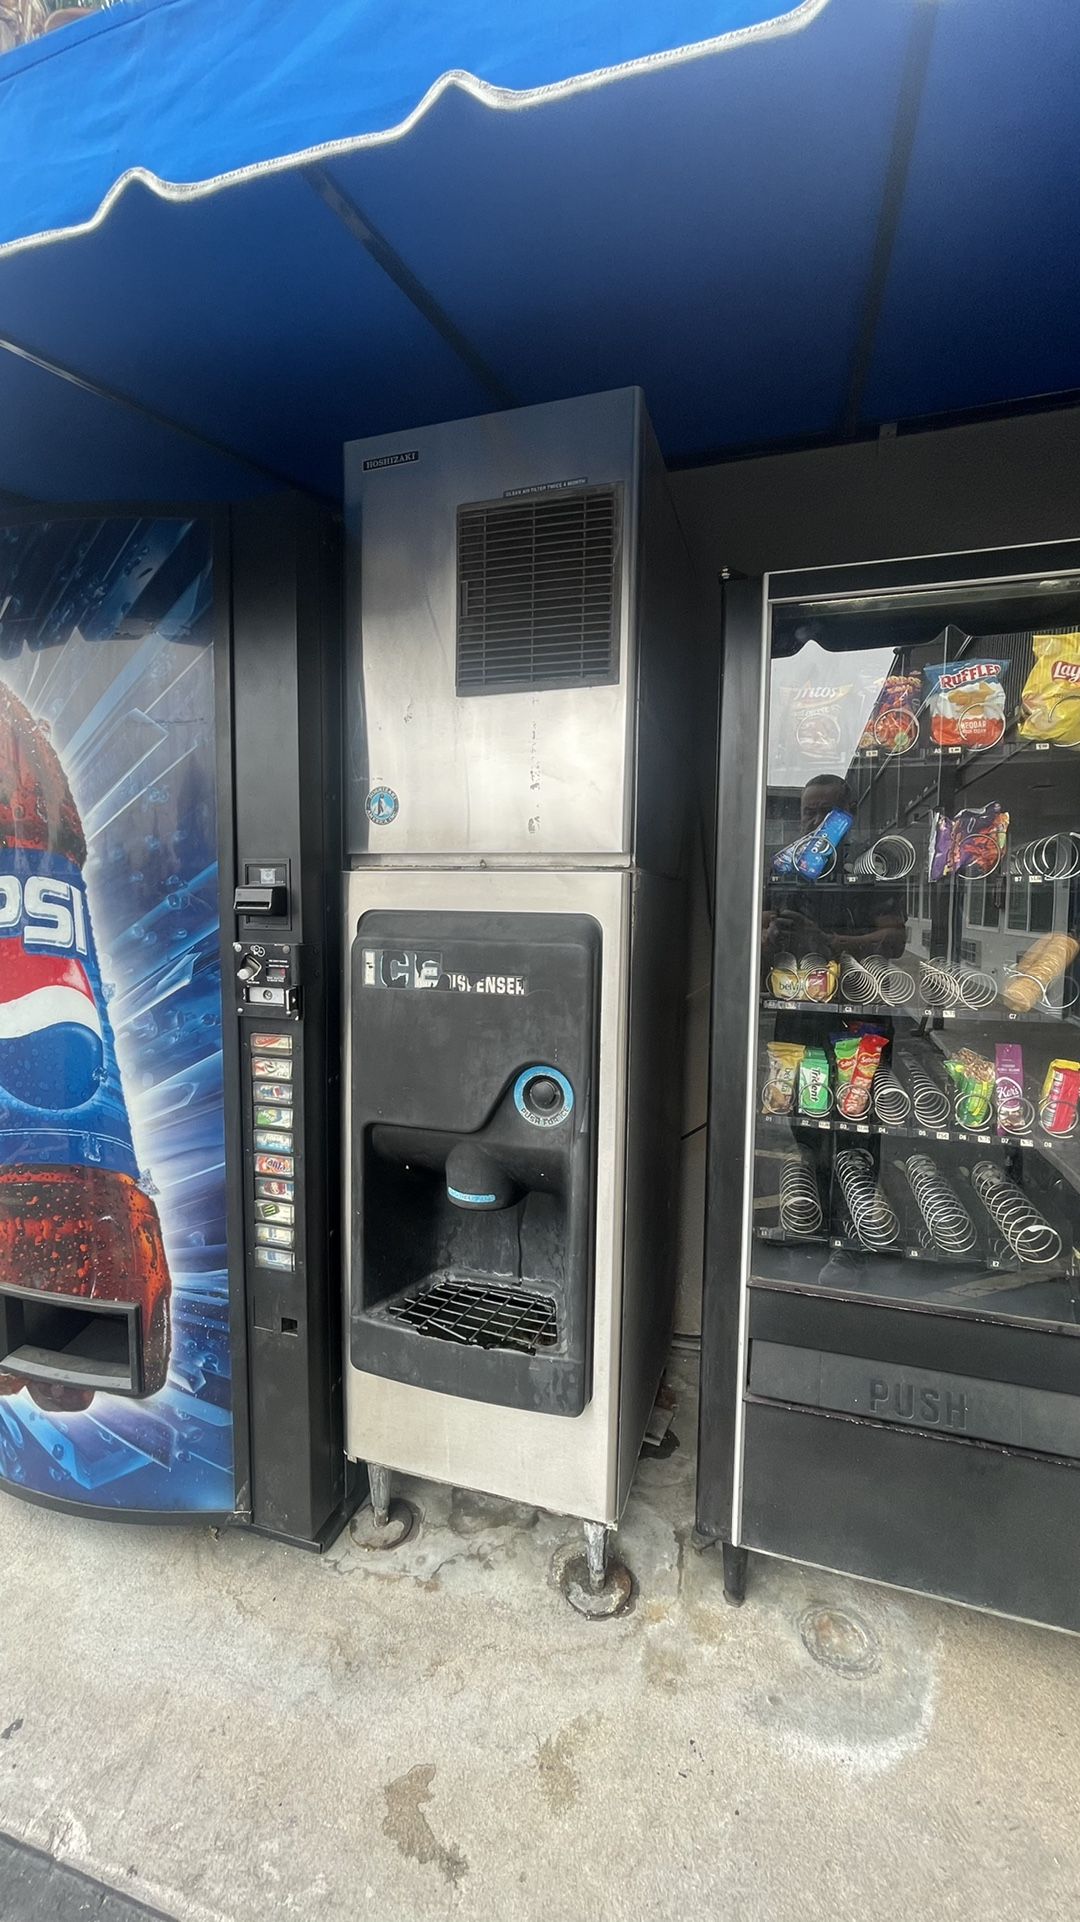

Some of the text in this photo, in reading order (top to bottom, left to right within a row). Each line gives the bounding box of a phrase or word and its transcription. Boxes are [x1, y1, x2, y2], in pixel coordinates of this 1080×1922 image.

[366, 452, 416, 469] HOSHIZAKI
[809, 1066, 821, 1103] Trident
[521, 1104, 570, 1125] PUSH FOR ICE
[868, 1379, 967, 1430] PUSH
